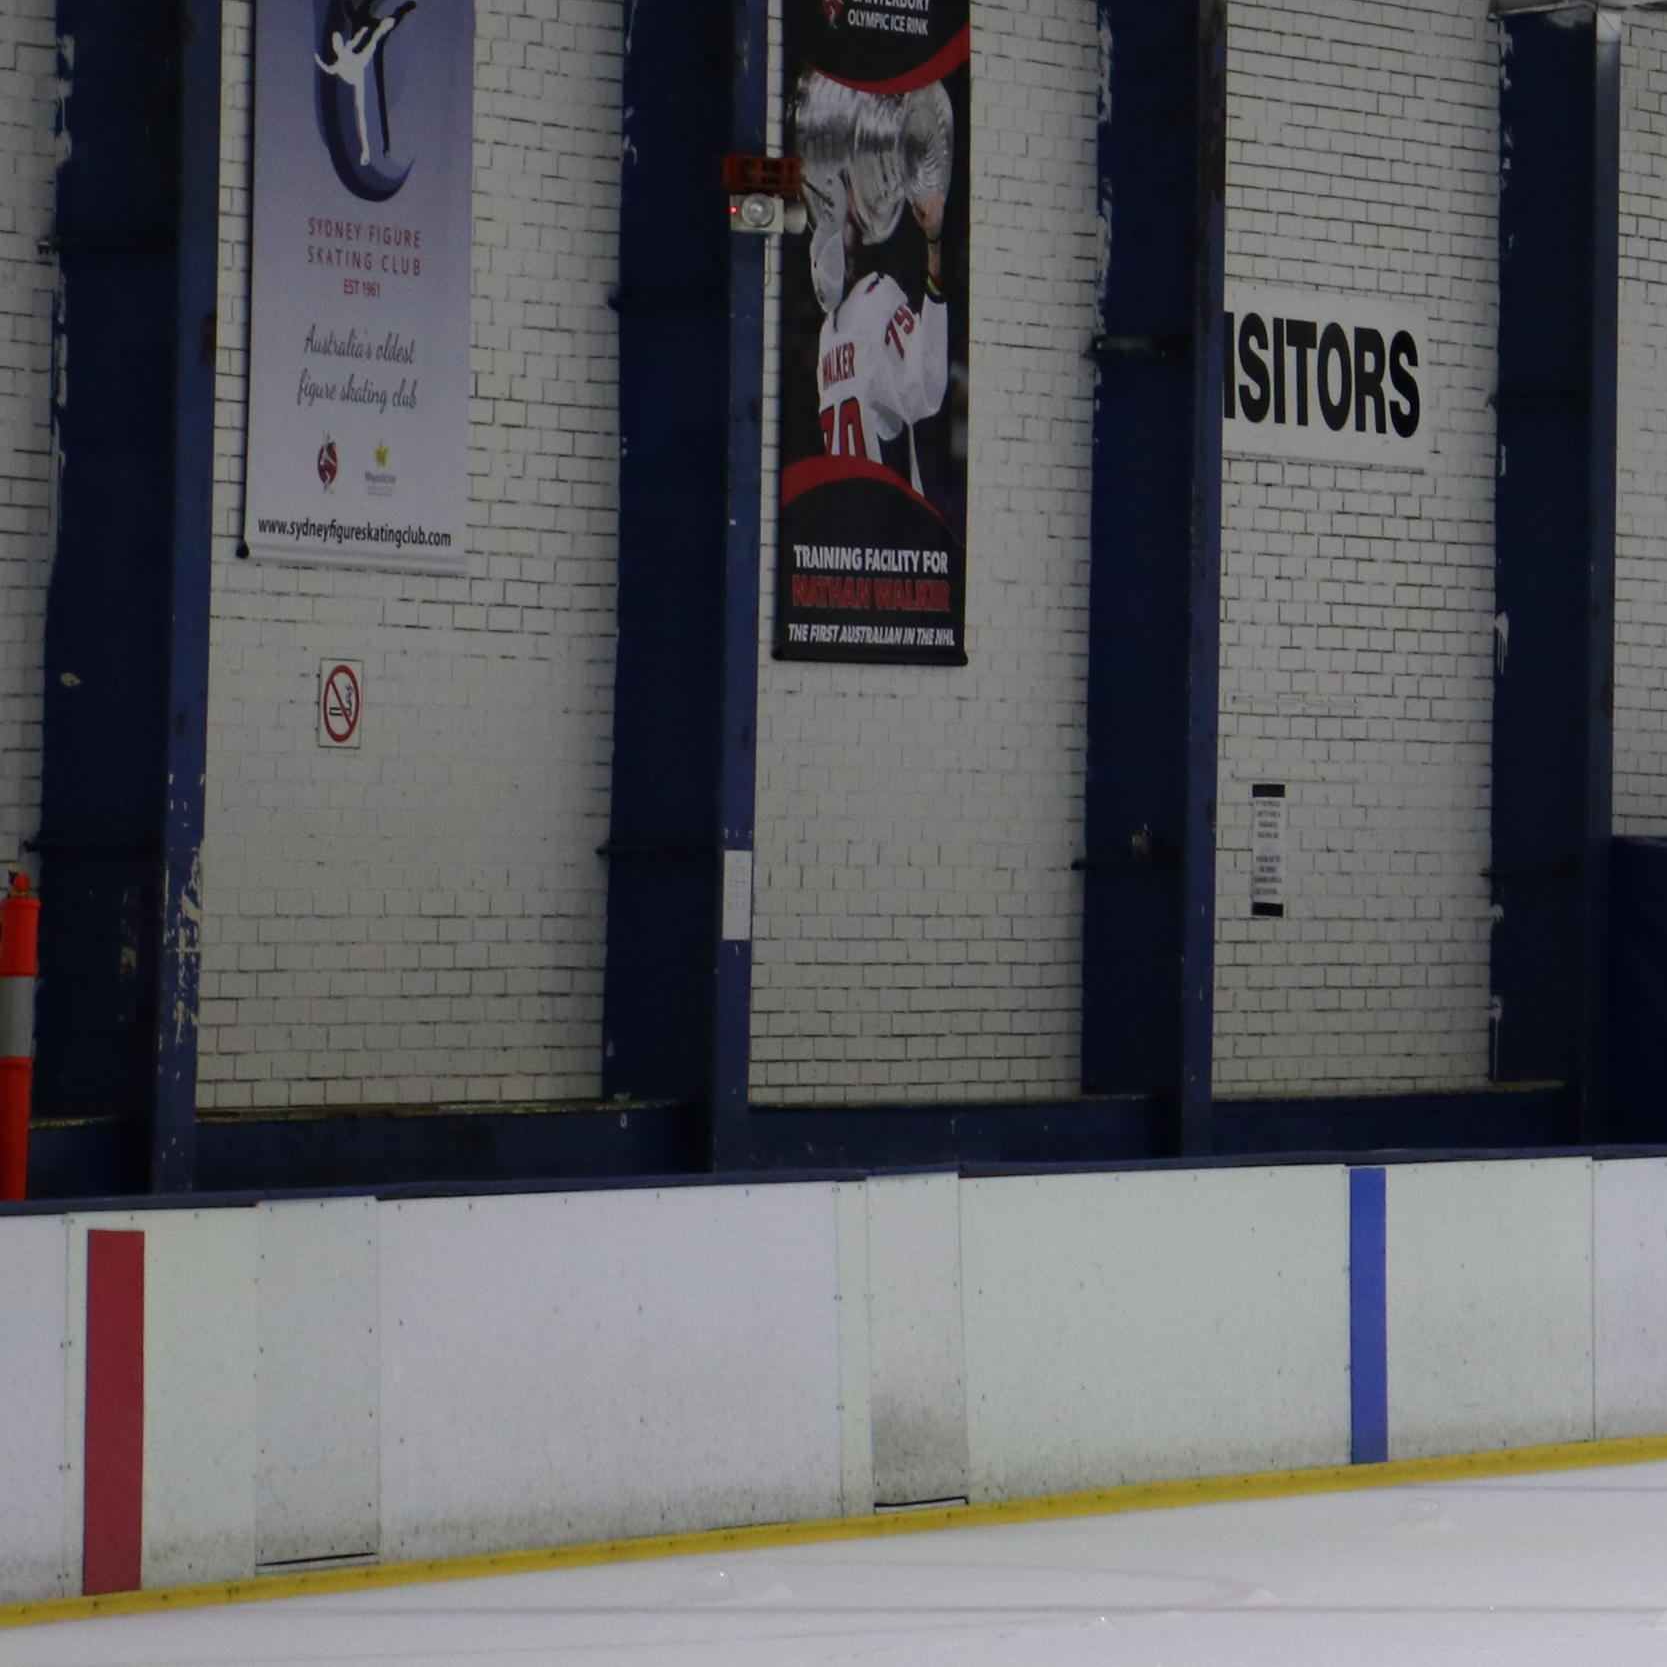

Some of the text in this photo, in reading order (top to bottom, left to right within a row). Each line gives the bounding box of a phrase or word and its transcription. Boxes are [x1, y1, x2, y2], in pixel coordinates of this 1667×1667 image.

[848, 9, 928, 35] OLYMPIC ICE RINK
[308, 217, 421, 249] SYDNEY FIGURE
[308, 245, 421, 276] SKATING CLUB
[343, 278, 360, 295] EST
[376, 332, 416, 364] oldest
[822, 342, 856, 391] WALKER
[1224, 311, 1421, 439] ISITORS
[297, 367, 417, 414] figure skating club
[258, 518, 452, 548] www.sydneyfigureskatingclub.com
[793, 545, 949, 575] TRAINING FACILITY FOR
[792, 574, 951, 612] NATHAN WALKER
[788, 623, 955, 648] THE FIRST AUSTRALIAN IN THE NHL
